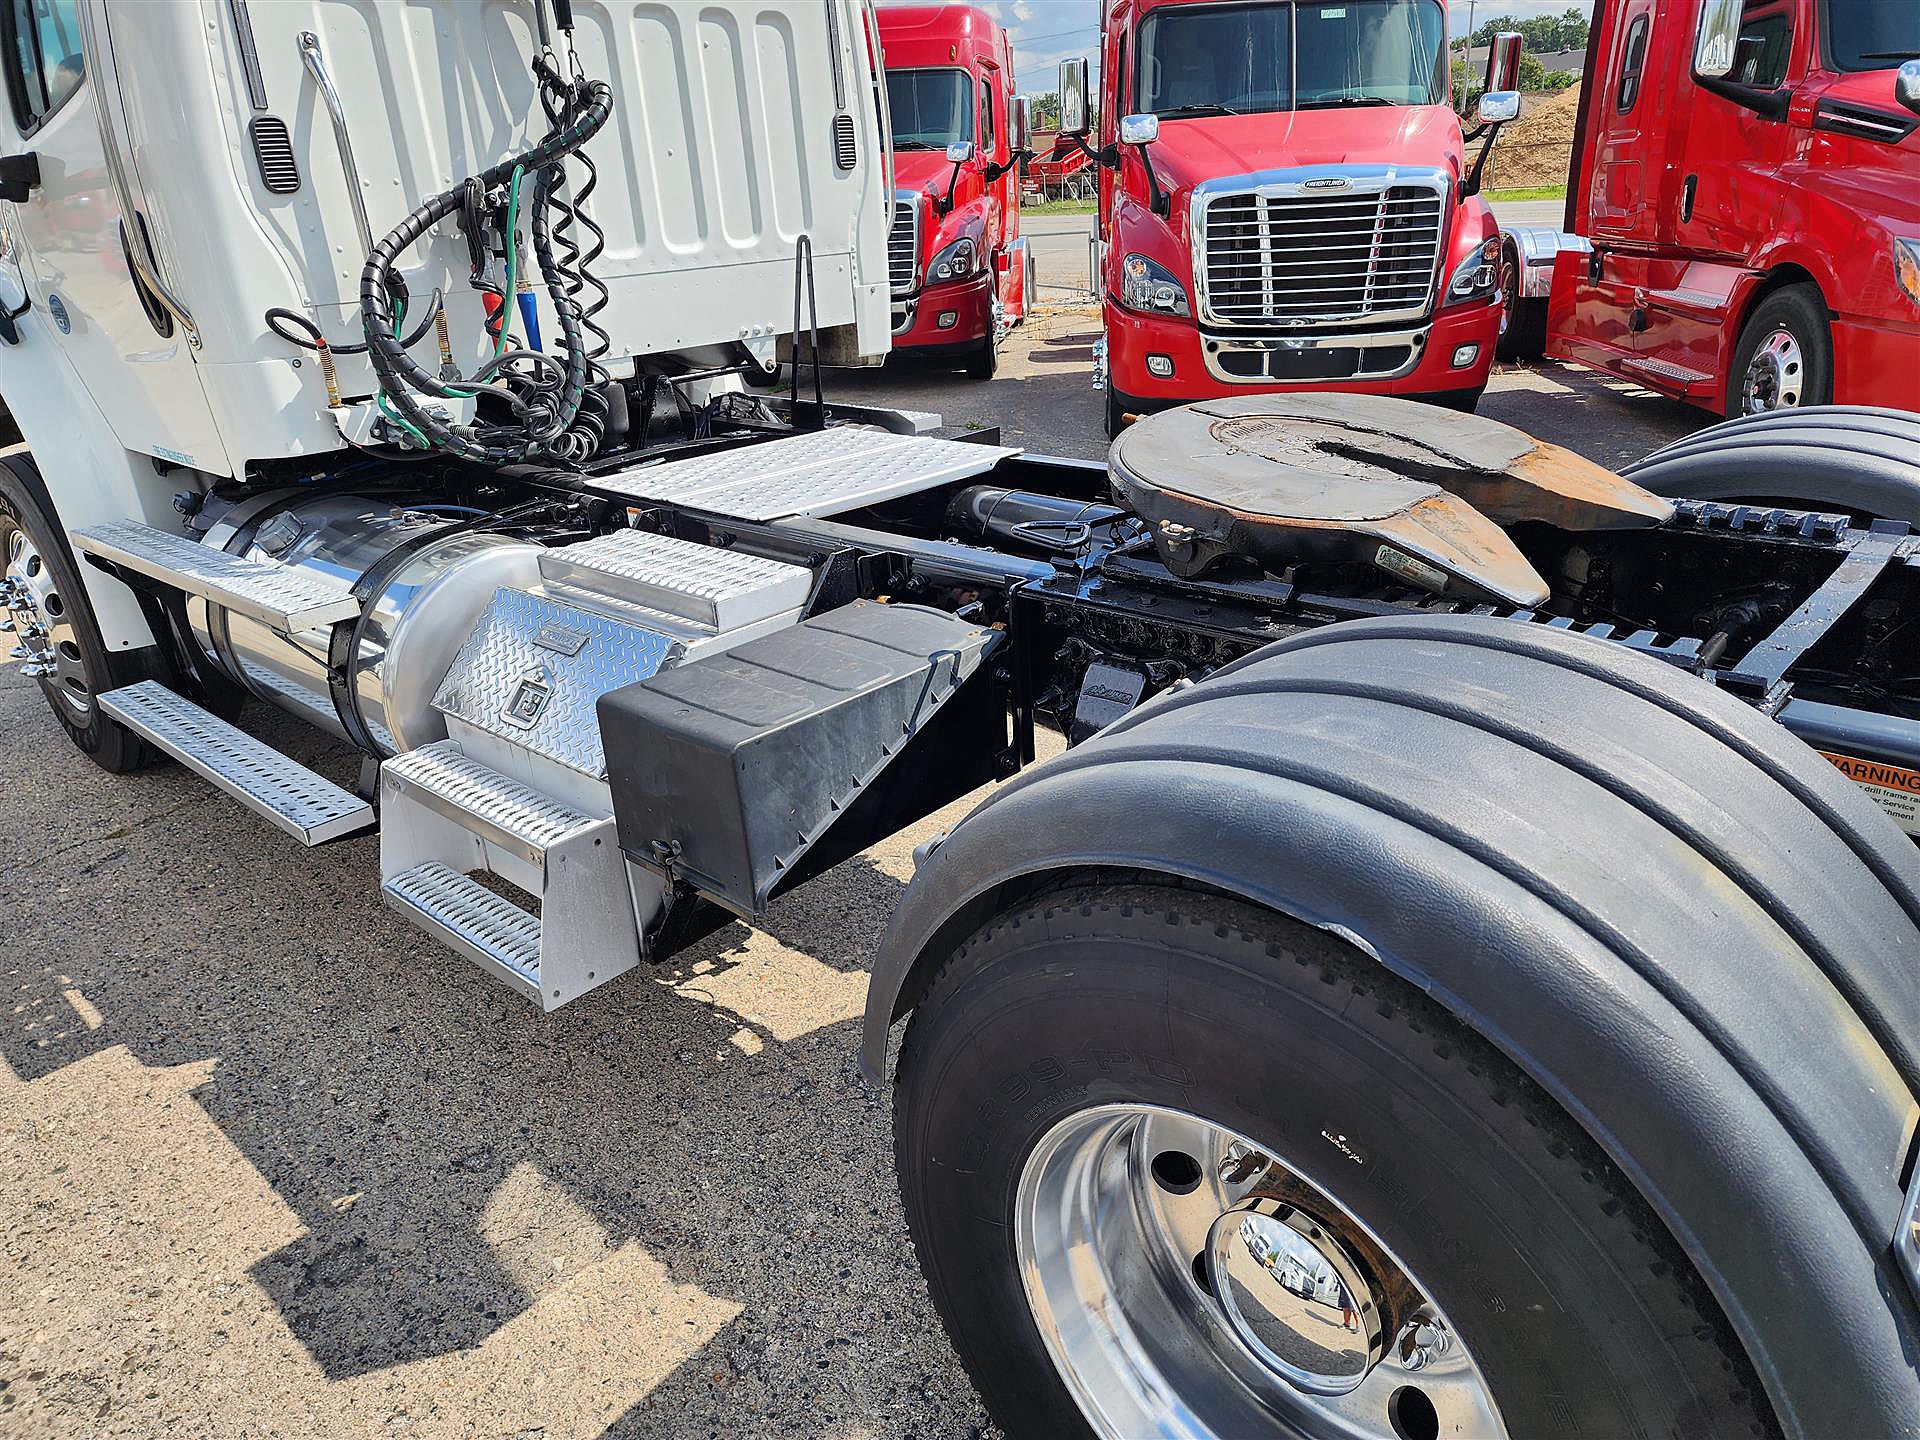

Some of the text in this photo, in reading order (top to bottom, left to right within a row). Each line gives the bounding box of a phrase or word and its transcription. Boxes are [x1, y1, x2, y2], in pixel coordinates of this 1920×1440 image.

[1827, 757, 1920, 790] ARNING
[1864, 786, 1882, 795] drill
[1883, 789, 1908, 801] frame
[1882, 798, 1915, 812] Service
